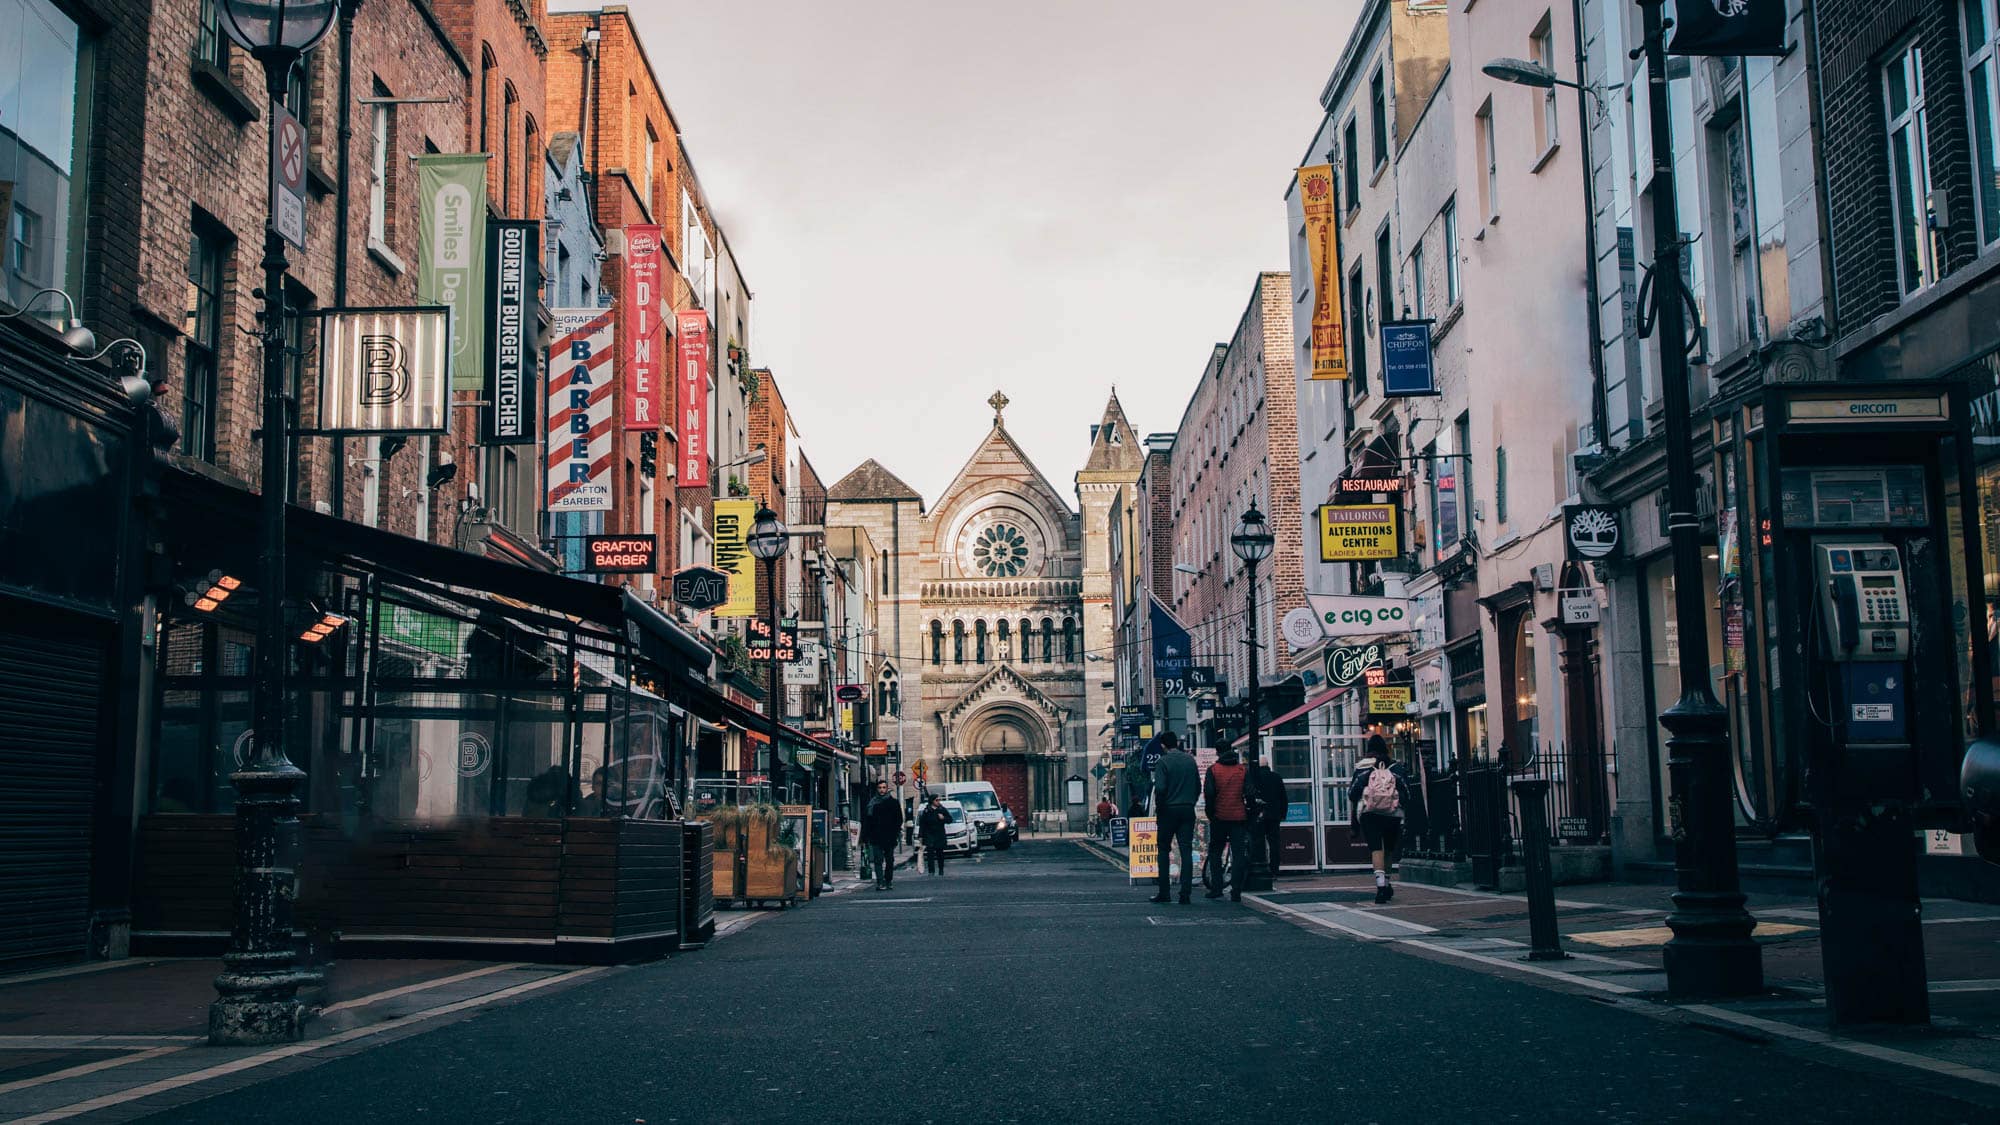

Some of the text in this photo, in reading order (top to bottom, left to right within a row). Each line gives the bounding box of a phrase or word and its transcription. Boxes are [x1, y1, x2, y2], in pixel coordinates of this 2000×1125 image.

[443, 194, 463, 262] Smiles
[1318, 224, 1331, 321] ALTERATION
[563, 315, 609, 324] GRAFTON
[500, 228, 521, 437] GOURMET BURGER KITCHEN
[565, 326, 605, 334] BARBER
[635, 281, 651, 422] DINER
[569, 340, 592, 484] BARBER
[1850, 403, 1897, 415] eircom
[686, 359, 700, 481] DINER
[561, 486, 607, 495] GRAFTON
[1342, 479, 1399, 492] RESTAURANT
[563, 497, 603, 506] BARBER
[1332, 510, 1386, 522] TAILORING
[1328, 525, 1393, 538] ALTERATIONS
[592, 541, 652, 552] GRAFTON
[1342, 537, 1379, 548] CENTRE
[1329, 550, 1358, 558] LADIES
[1366, 549, 1393, 557] GENTS
[596, 554, 648, 566] BARBER
[676, 577, 723, 601] EAT
[1324, 611, 1336, 624] e
[1377, 606, 1404, 621] co
[1574, 611, 1589, 620] 30
[1154, 660, 1191, 668] MAGEE
[1367, 676, 1385, 685] BAR
[1165, 679, 1186, 696] 22
